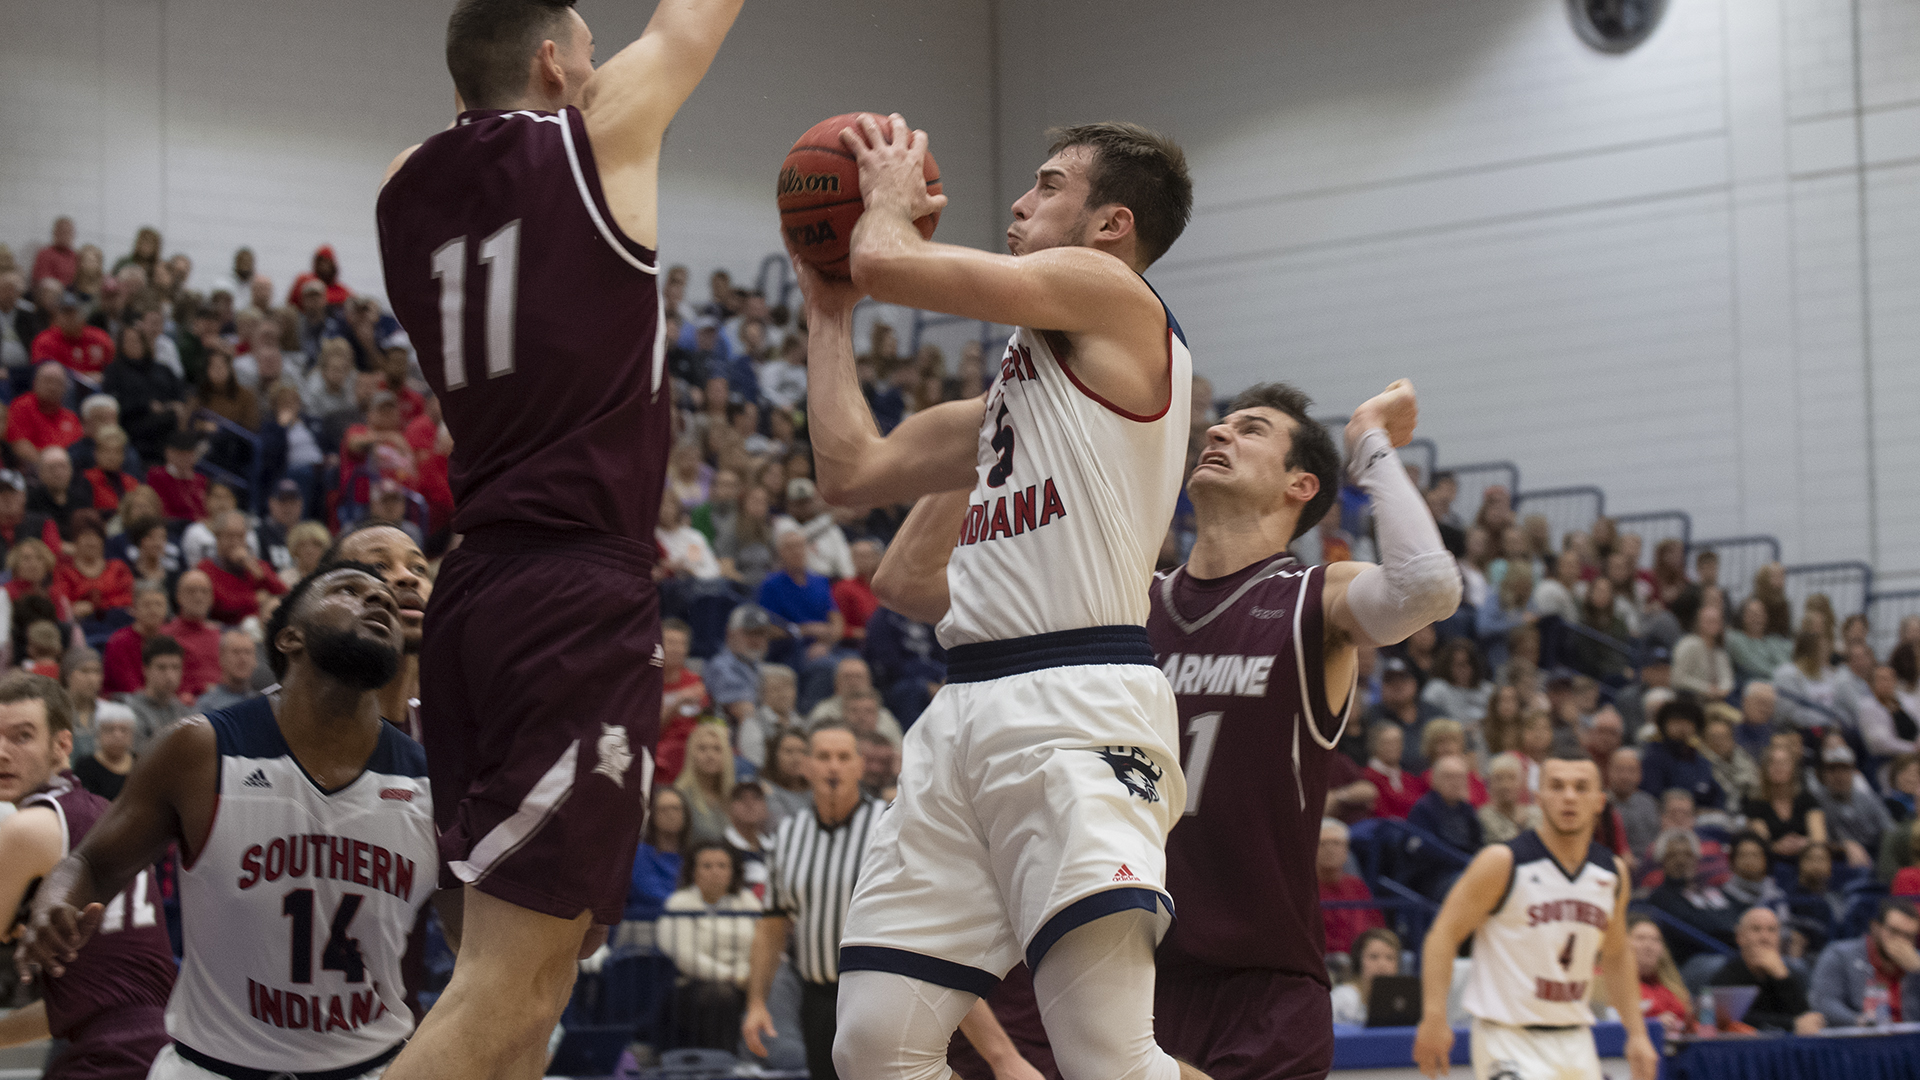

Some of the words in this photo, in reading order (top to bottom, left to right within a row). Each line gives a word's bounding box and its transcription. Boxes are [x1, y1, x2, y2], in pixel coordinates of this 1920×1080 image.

[430, 218, 522, 392] 11
[1154, 652, 1278, 697] ARMINE
[238, 834, 416, 903] SOUTHERN
[283, 888, 365, 985] 14
